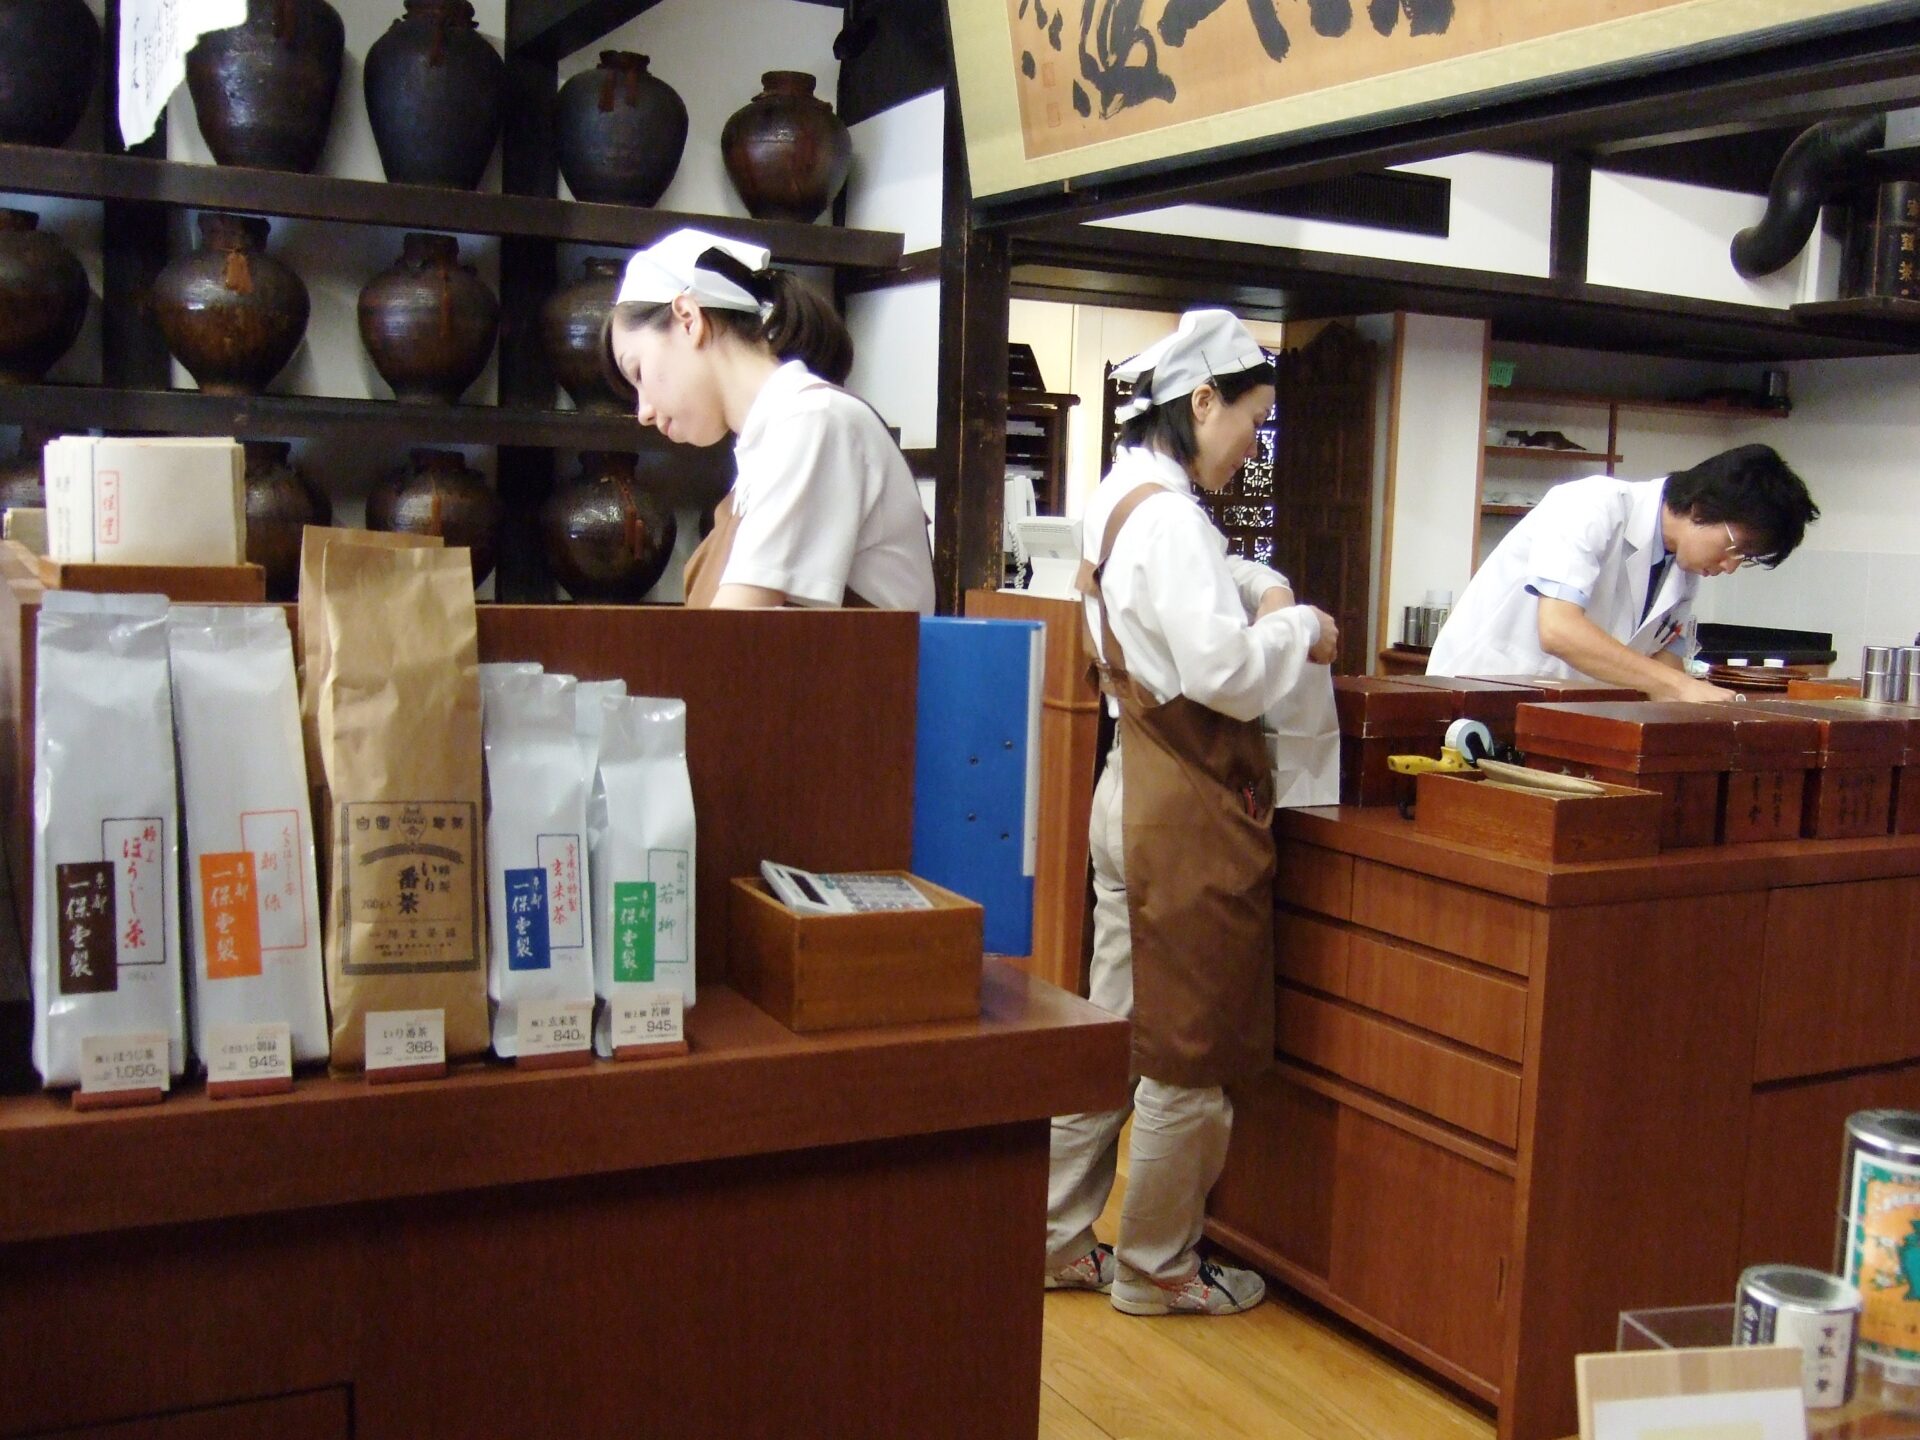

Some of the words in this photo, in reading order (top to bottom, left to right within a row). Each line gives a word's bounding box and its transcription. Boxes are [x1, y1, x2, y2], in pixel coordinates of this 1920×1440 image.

[65, 879, 93, 978] 一保堂製
[123, 839, 146, 949] ほうじ茶
[208, 868, 241, 963] 一保堂製
[397, 864, 421, 915] 番茶
[512, 880, 534, 959] 一保堂製
[550, 858, 568, 926] 玄米茶
[382, 1026, 429, 1040] いり番茶
